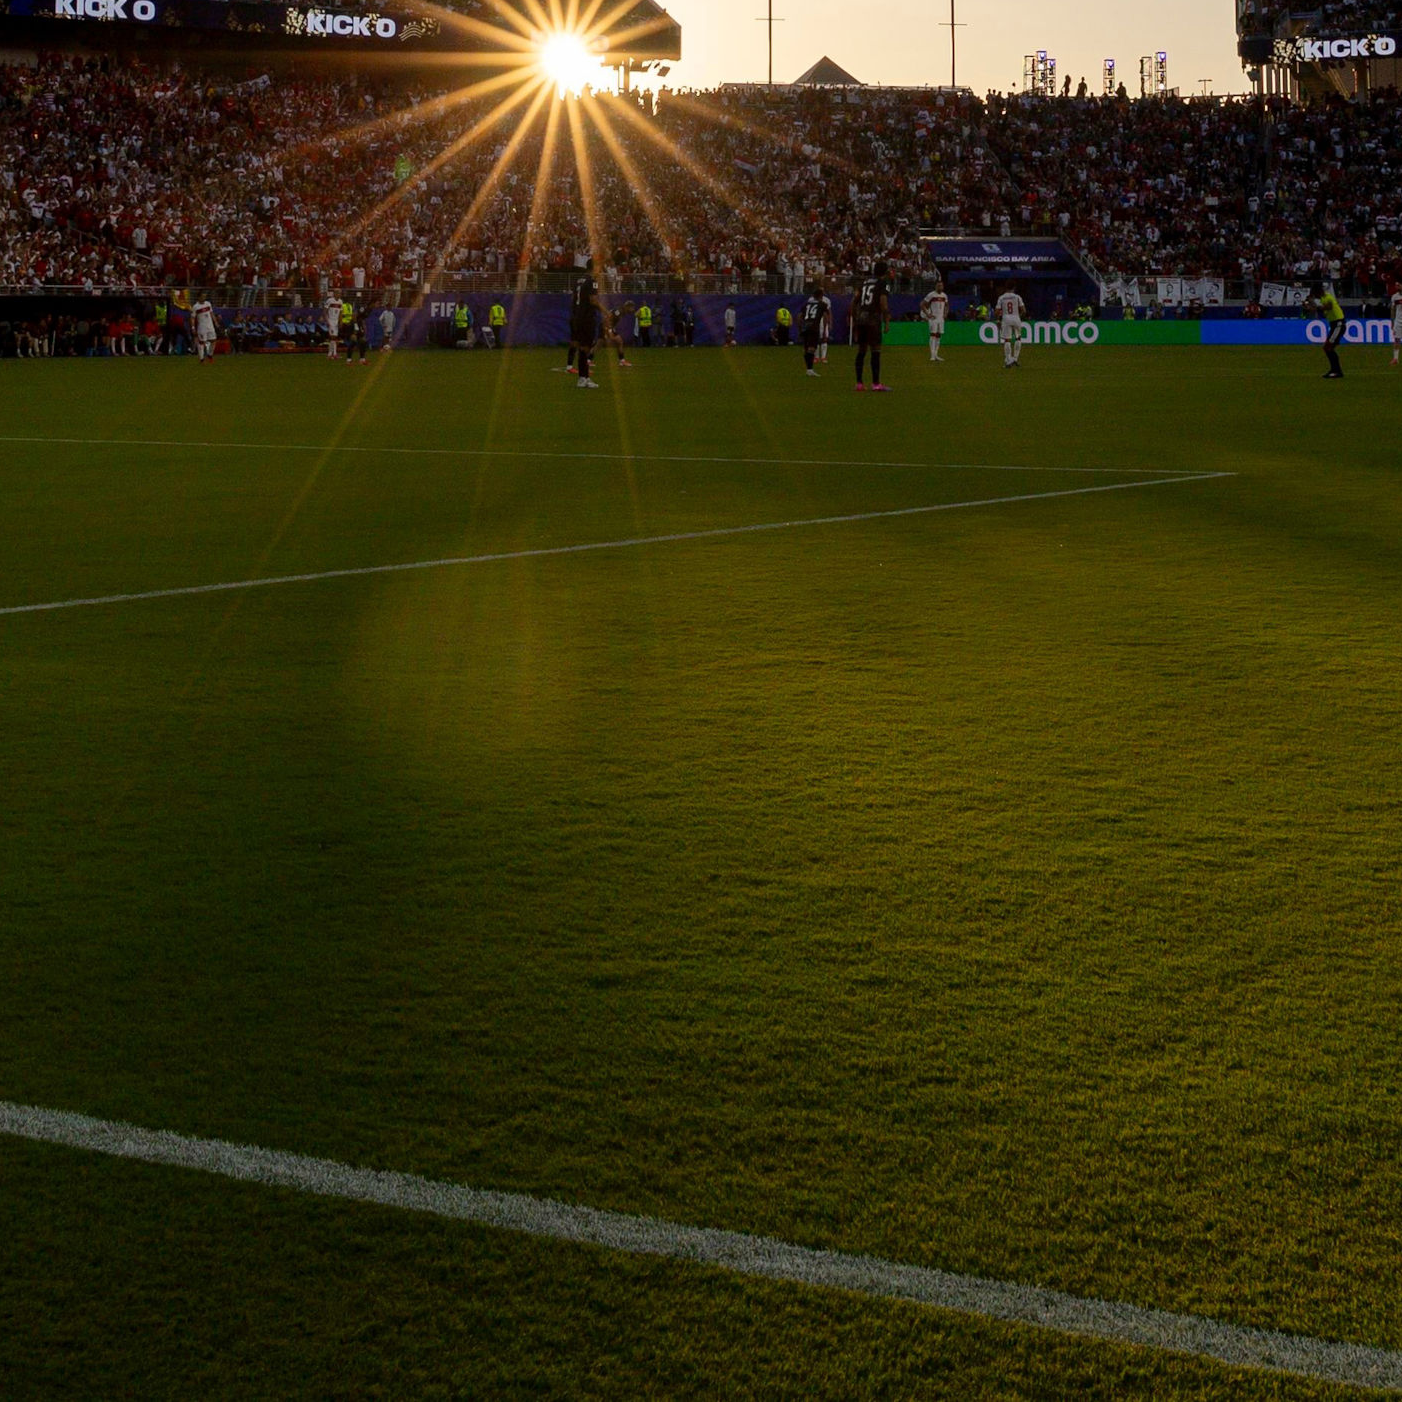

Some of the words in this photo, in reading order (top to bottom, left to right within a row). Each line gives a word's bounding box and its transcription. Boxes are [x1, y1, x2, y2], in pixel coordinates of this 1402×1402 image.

[132, 0, 156, 21] O
[306, 13, 372, 37] KICK
[375, 17, 397, 38] O
[1303, 38, 1371, 59] KICK
[1374, 37, 1396, 56] O
[861, 284, 876, 306] 15
[430, 302, 456, 317] FIF
[804, 304, 819, 320] 14
[979, 321, 1099, 344] aamco
